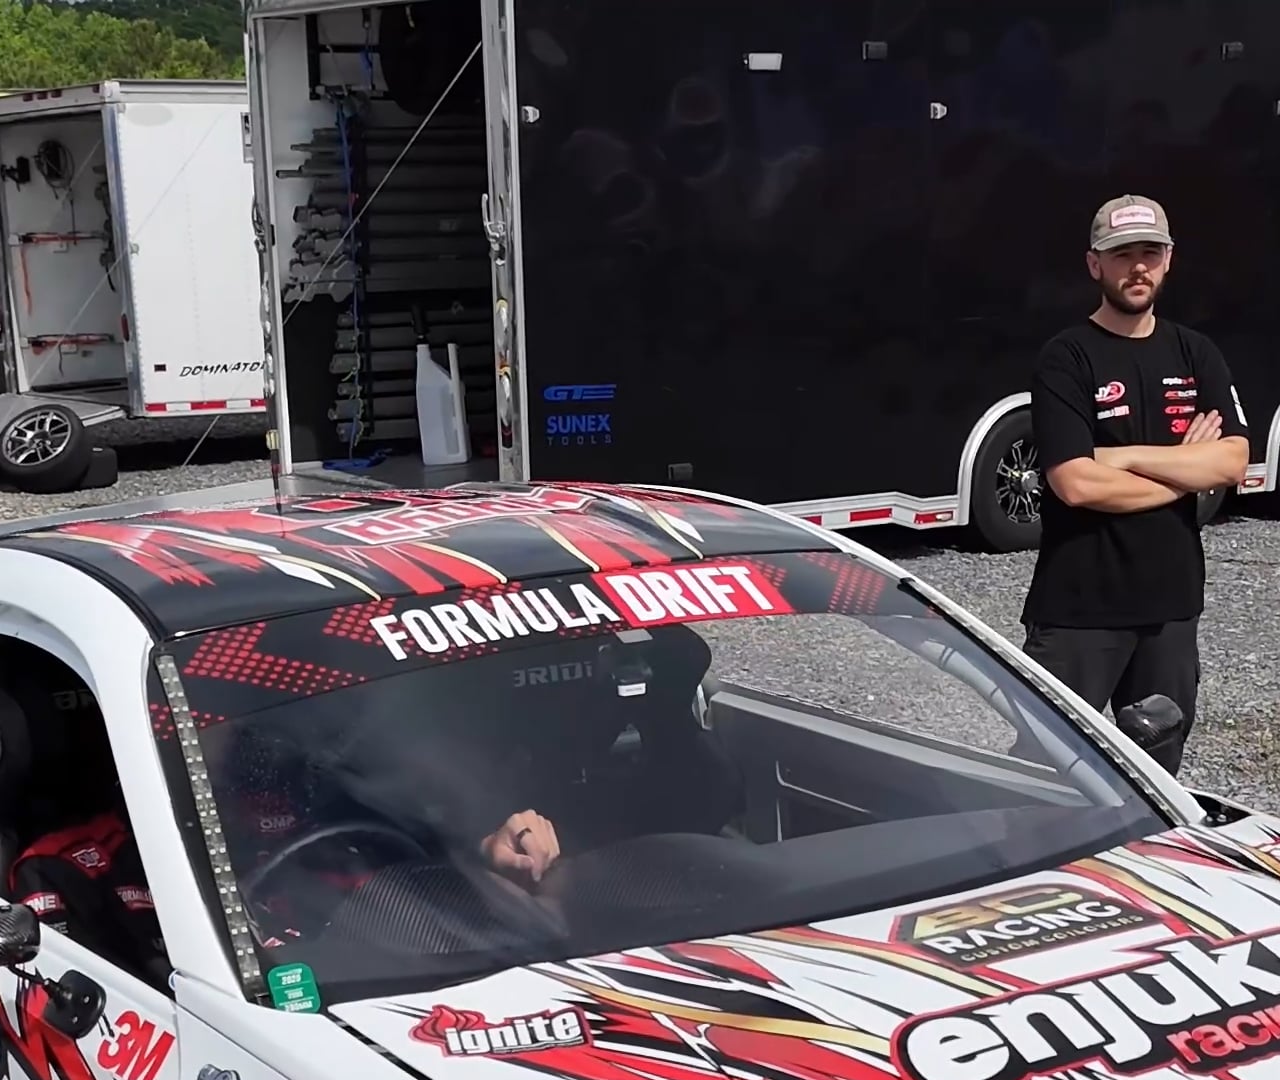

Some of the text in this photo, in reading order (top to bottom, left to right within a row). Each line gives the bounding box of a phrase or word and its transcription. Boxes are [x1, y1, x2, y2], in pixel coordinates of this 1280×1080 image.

[547, 414, 611, 433] SUNEX
[547, 434, 612, 446] TOOLS
[369, 565, 775, 662] FORMULA DRIFT
[922, 900, 1122, 954] RACING
[961, 914, 1145, 962] CUSTOM COILOVERS
[445, 1010, 583, 1055] ignite
